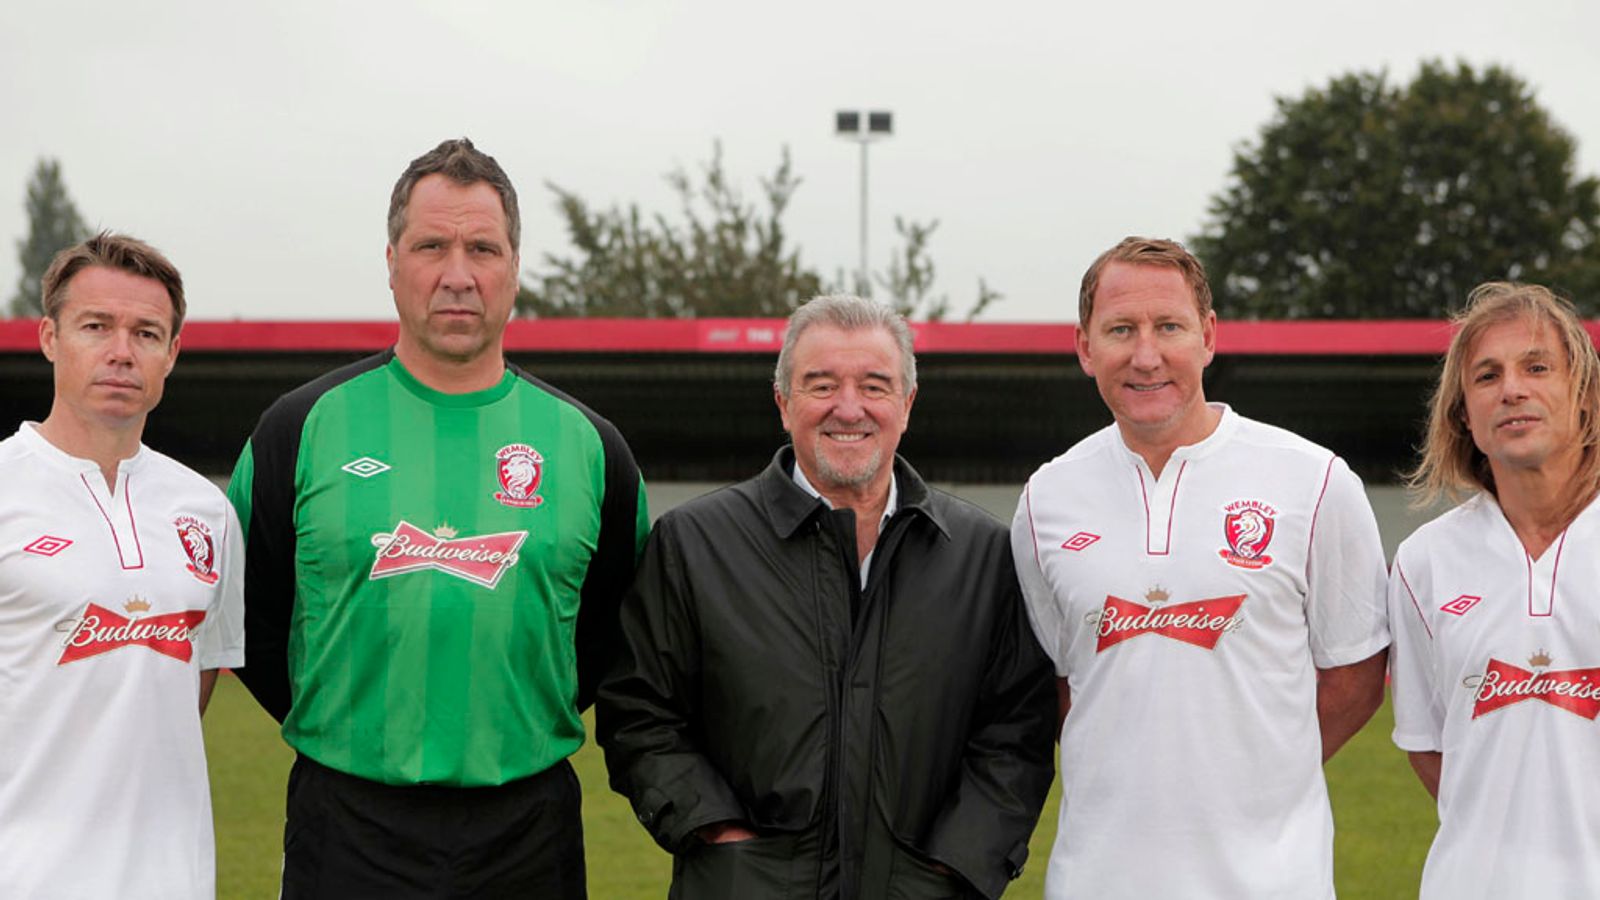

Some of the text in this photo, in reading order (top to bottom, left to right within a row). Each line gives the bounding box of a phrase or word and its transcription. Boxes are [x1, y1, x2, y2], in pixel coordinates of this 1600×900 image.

[497, 444, 542, 461] WEMBLEY
[1225, 500, 1277, 516] WEMBLEY
[371, 533, 519, 568] Budweiser
[54, 614, 198, 647] Budweis
[1084, 605, 1244, 638] Budweiser
[1462, 670, 1600, 702] Budweise
